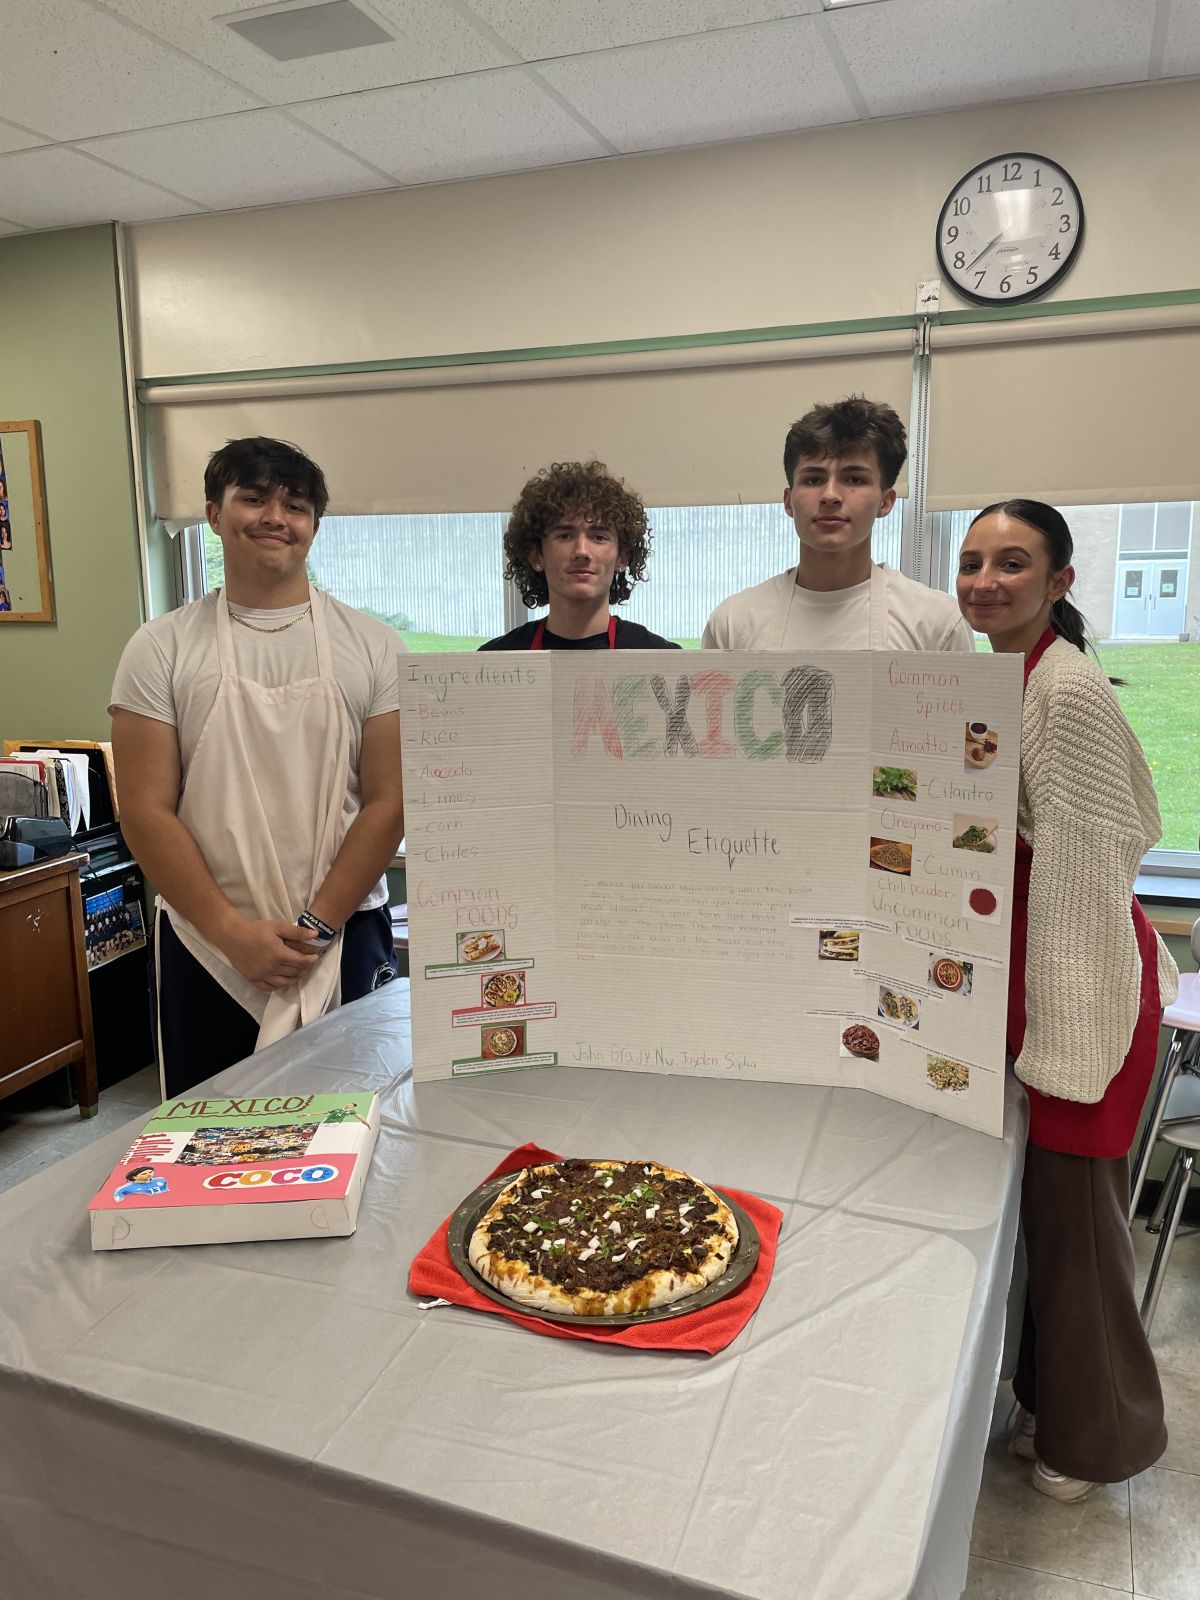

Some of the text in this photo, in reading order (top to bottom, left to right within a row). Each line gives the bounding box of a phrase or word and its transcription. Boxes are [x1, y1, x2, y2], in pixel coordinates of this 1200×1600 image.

[1002, 162, 1022, 182] 12
[1033, 168, 1042, 188] 1
[977, 174, 993, 194] 11
[952, 196, 971, 217] 10
[1050, 187, 1064, 206] 2
[1058, 214, 1071, 233] 3
[946, 226, 959, 245] 9
[953, 251, 966, 269] 8
[1048, 242, 1061, 260] 4
[974, 270, 987, 290] 7
[999, 274, 1013, 293] 6
[1026, 265, 1039, 284] 5
[408, 663, 537, 703] Ingredients
[887, 658, 960, 688] Common
[916, 690, 966, 719] Spices
[569, 665, 836, 765] MEXICO
[614, 803, 673, 843] Dining
[688, 827, 781, 872] Etiquette
[871, 891, 970, 933] Uncommon
[207, 1166, 336, 1189] COCO
